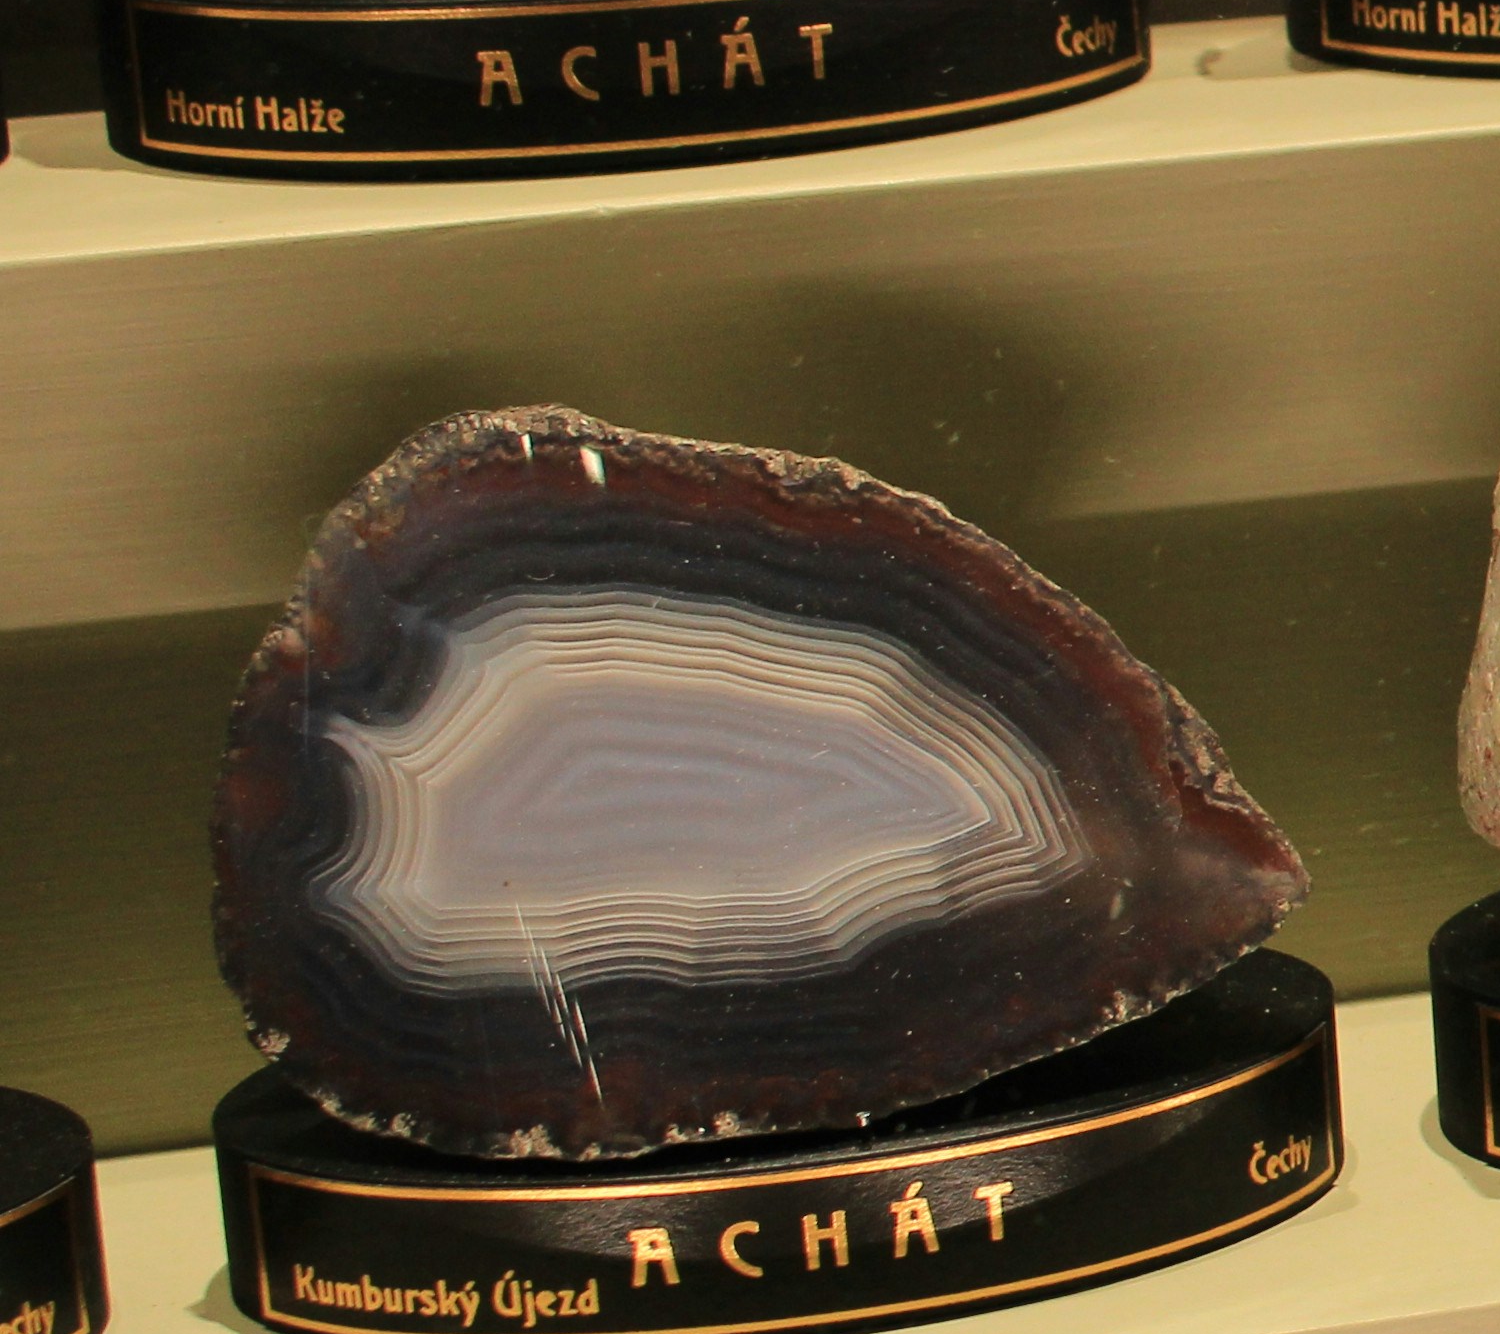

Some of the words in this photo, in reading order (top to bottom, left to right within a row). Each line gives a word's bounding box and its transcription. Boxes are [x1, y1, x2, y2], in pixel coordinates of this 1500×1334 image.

[474, 13, 833, 106] ACHÁT
[1055, 15, 1118, 57] Čechy
[166, 89, 244, 129] Horní
[254, 97, 344, 133] Halže
[1248, 1136, 1311, 1184] Čechy
[631, 1183, 1013, 1286] ACHÁT
[295, 1266, 480, 1325] Kumburský
[491, 1270, 599, 1328] Újezd
